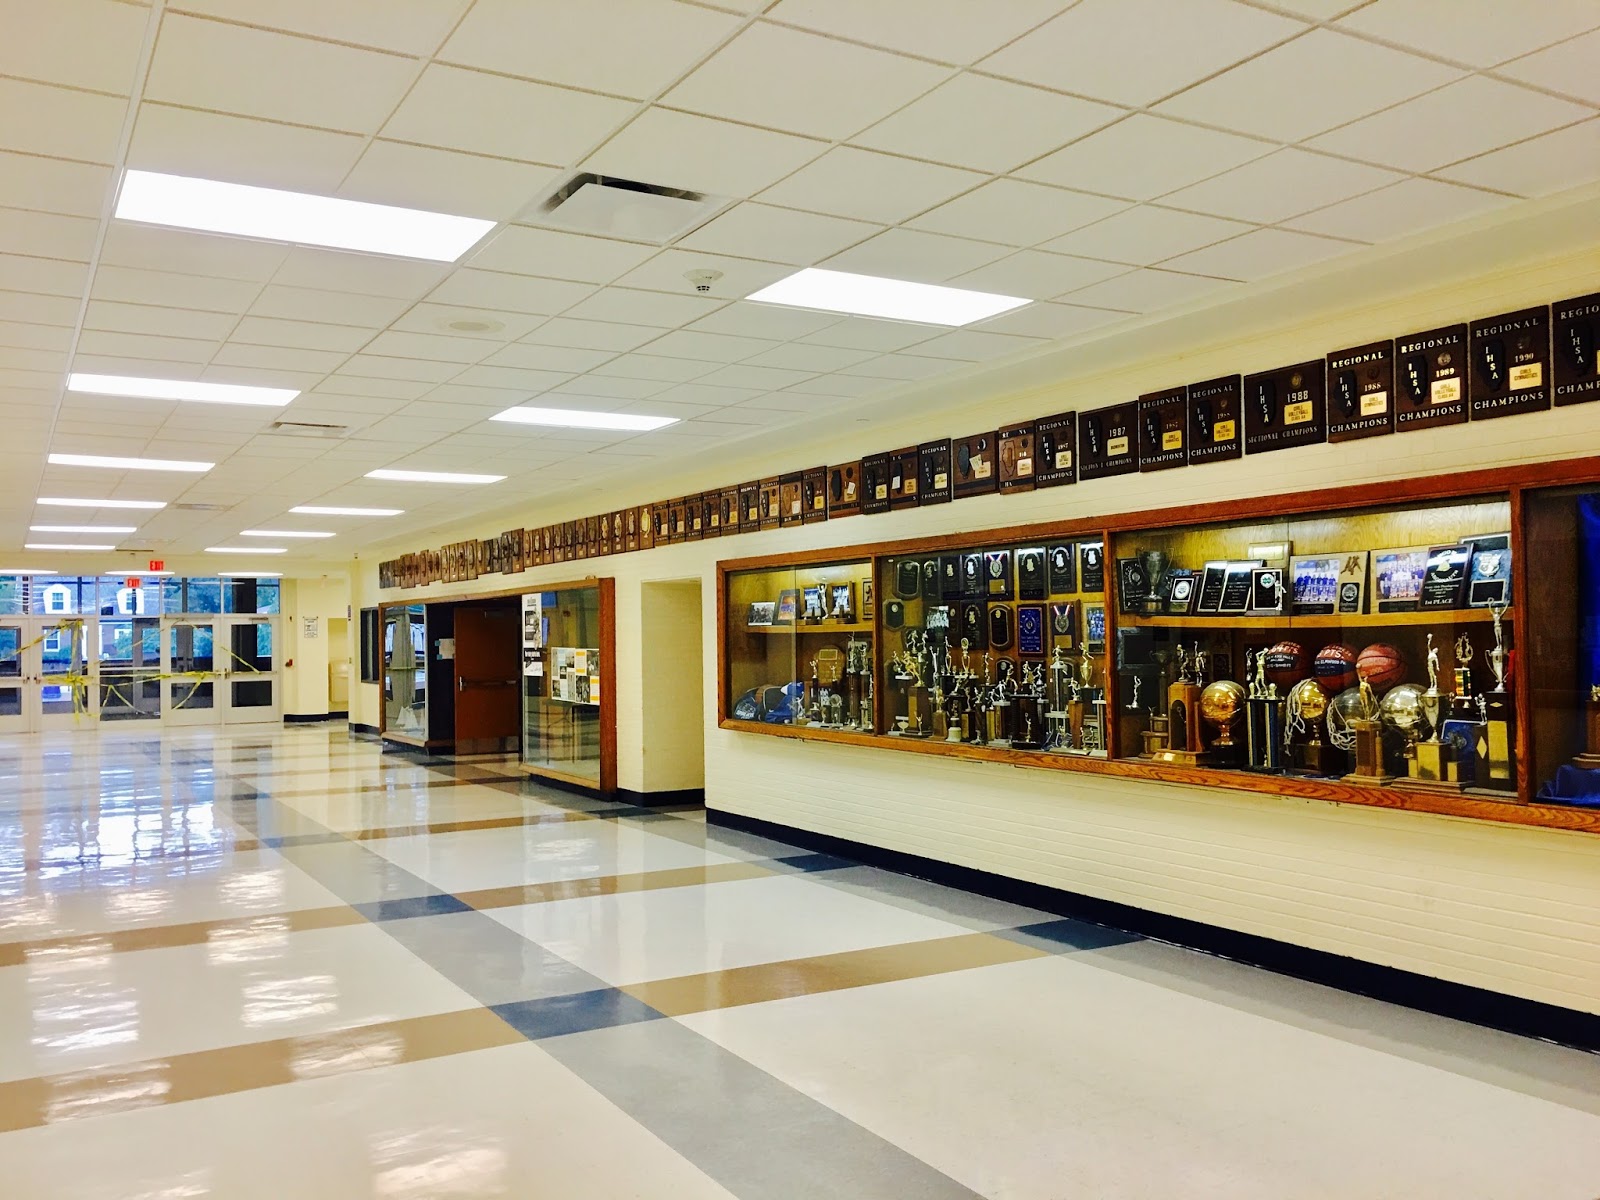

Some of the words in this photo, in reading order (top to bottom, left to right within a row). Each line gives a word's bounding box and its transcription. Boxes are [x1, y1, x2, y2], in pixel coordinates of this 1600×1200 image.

[1476, 318, 1539, 338] REGIONAL
[1401, 335, 1458, 354] REGIONAL
[1332, 351, 1384, 369] REGIONAL
[1515, 353, 1534, 363] 1990
[1435, 367, 1455, 378] 1989
[1192, 384, 1233, 399] REGIONAL
[1364, 382, 1381, 392] 1988
[1142, 396, 1180, 409] REGIONAL
[1287, 390, 1308, 403] 1988
[1474, 391, 1544, 410] CHAMPIONS
[1400, 405, 1462, 421] CHAMPIONS
[1039, 420, 1070, 431] REGIONAL
[1331, 417, 1388, 433] CHAMPIONS
[1109, 426, 1126, 438] 1987
[1247, 432, 1278, 444] SECTIONAL
[1282, 426, 1318, 437] CHAMPIONS
[1191, 443, 1236, 457] CHAMPIONS
[1141, 451, 1184, 464] CHAMPIONS
[1038, 471, 1073, 481] CHAMPIONS
[149, 560, 164, 571] EXIT
